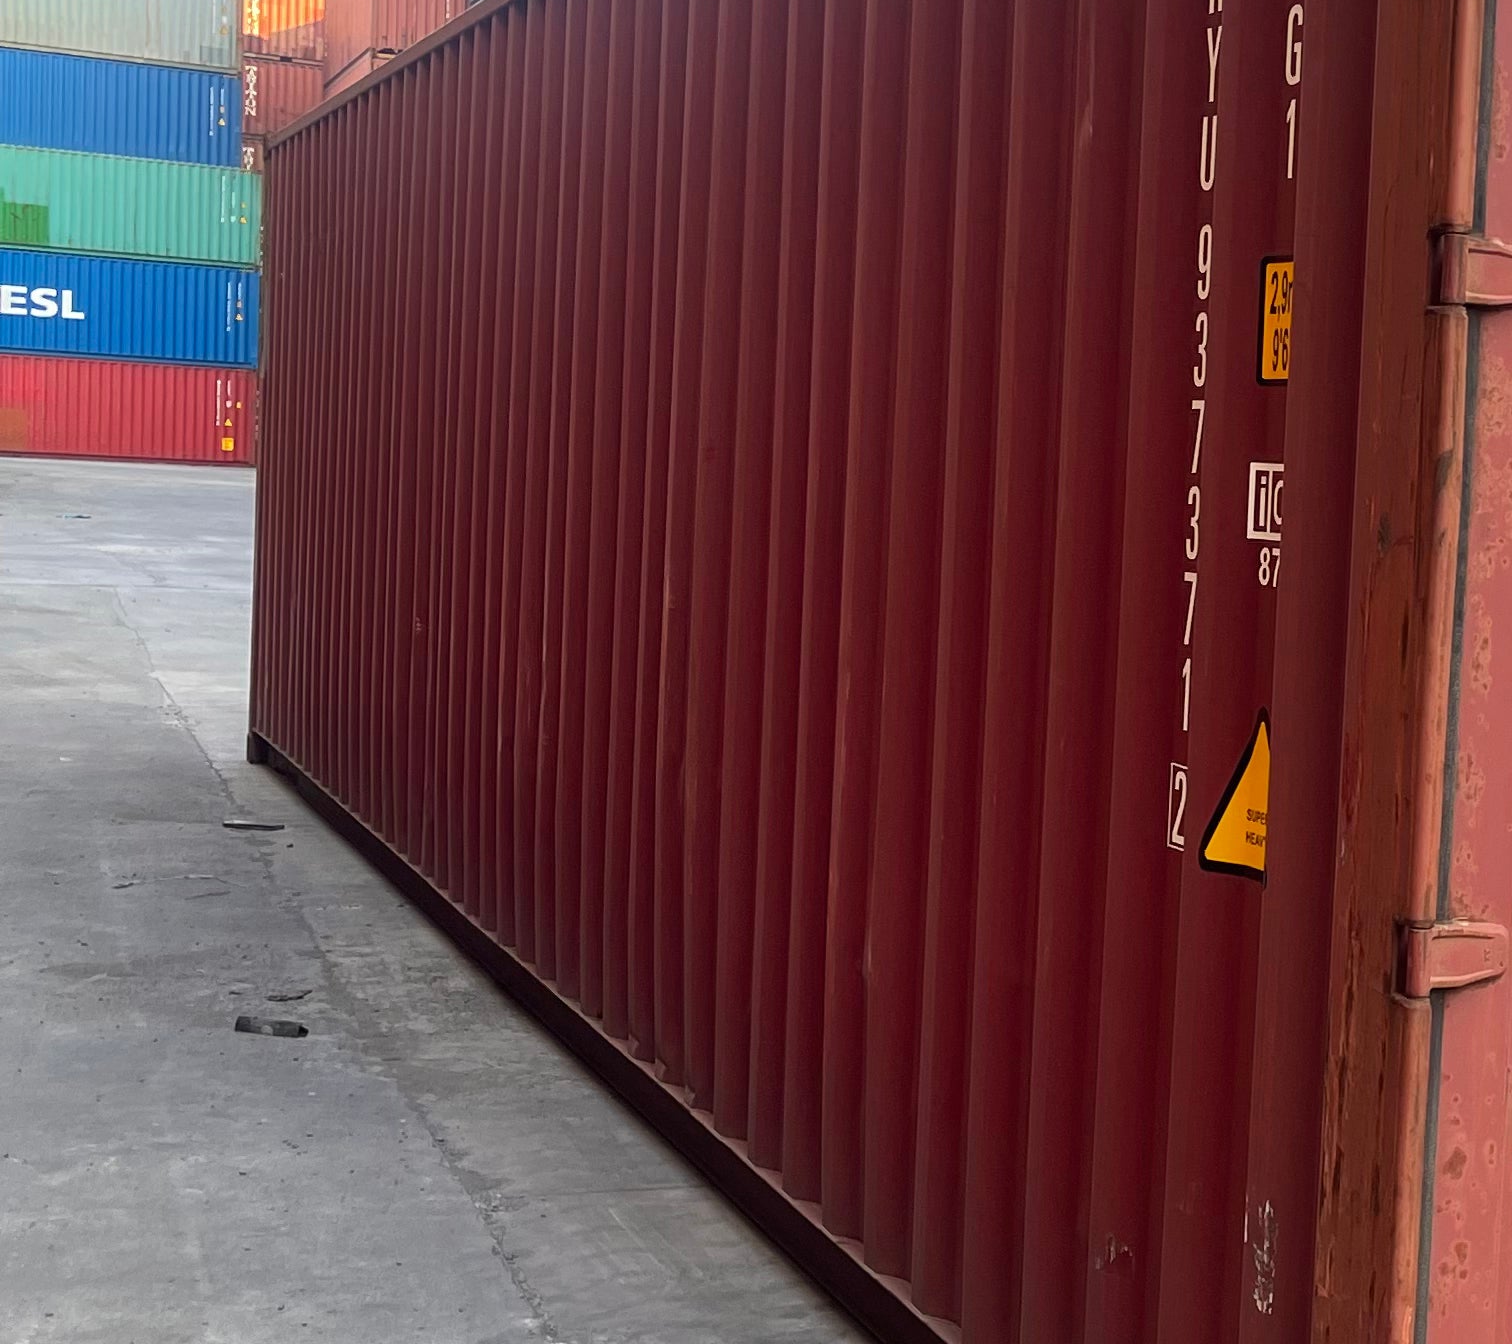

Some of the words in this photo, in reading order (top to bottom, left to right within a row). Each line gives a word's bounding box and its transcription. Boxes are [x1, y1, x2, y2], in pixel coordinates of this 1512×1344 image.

[0, 284, 86, 320] ESL
[1182, 224, 1212, 732] 937371
[1246, 808, 1267, 825] SUPE
